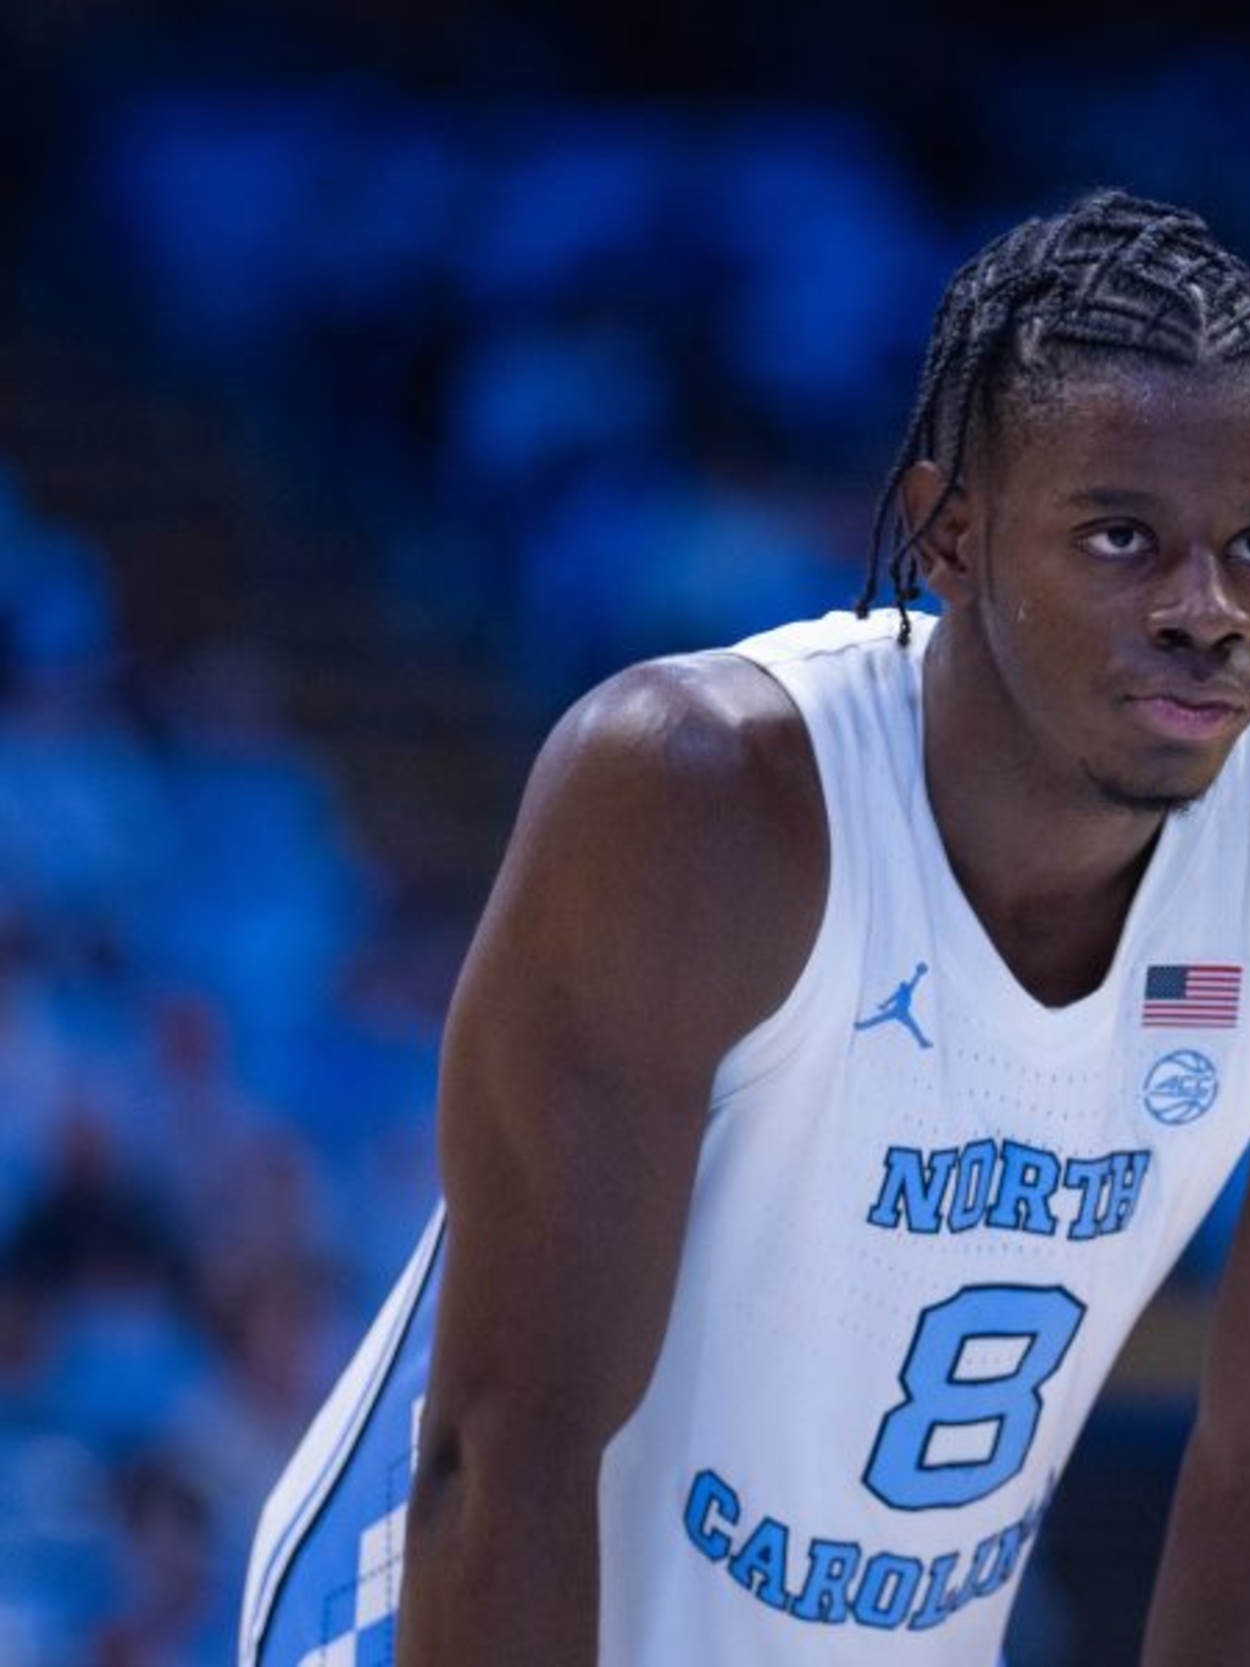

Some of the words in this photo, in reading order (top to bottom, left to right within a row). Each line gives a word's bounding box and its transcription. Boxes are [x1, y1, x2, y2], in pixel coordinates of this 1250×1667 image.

[1149, 1074, 1210, 1099] ACC
[866, 1138, 1152, 1240] NORTH
[861, 1284, 1087, 1511] 8
[683, 1468, 1056, 1631] CAROLIN
